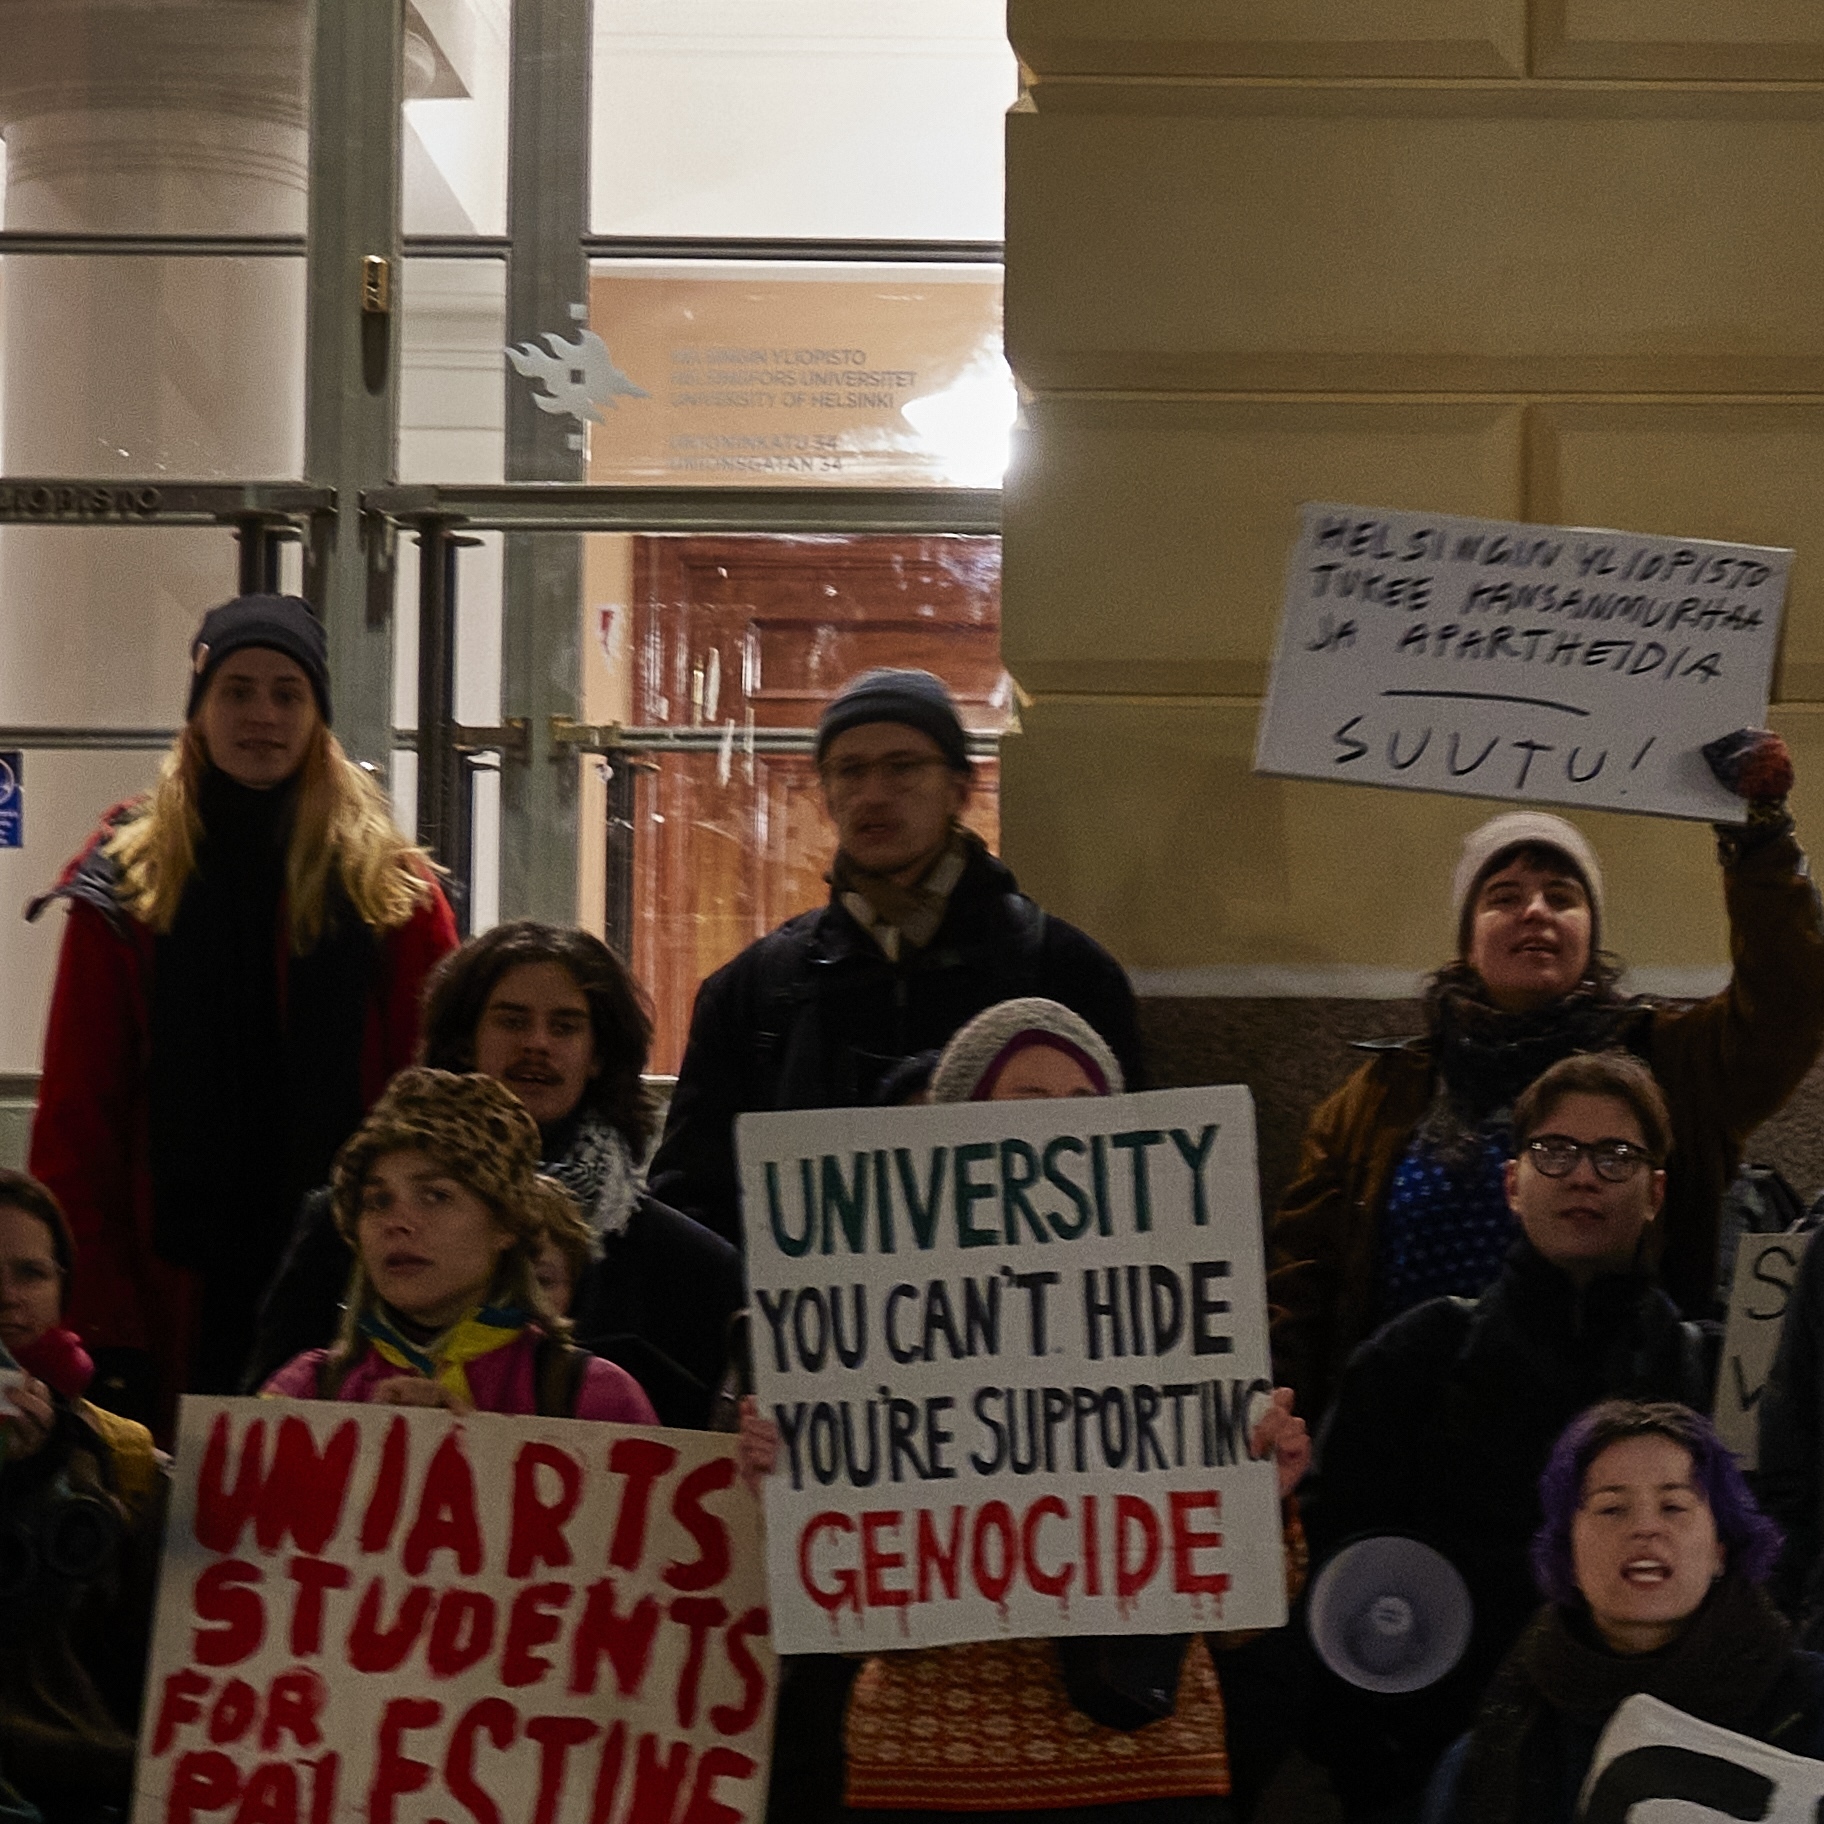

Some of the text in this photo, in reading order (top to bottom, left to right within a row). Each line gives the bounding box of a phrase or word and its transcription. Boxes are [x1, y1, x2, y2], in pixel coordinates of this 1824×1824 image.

[772, 349, 866, 365] YLIOPISTO
[811, 392, 894, 408] HELSINKI
[1576, 545, 1772, 591] YLIOPISTO
[1307, 612, 1723, 684] JA APARTHEIDIA
[1334, 714, 1657, 796] SUUTU!
[765, 1123, 1222, 1259] UNIVERSITY
[755, 1260, 1234, 1375] YOU CAN'T HIDE
[775, 1384, 958, 1491] YOU'RE
[194, 1410, 739, 1592] UNIARTS
[798, 1488, 1233, 1620] GENOCIDE
[192, 1556, 770, 1737] STUDENTS
[150, 1666, 327, 1758] FOR
